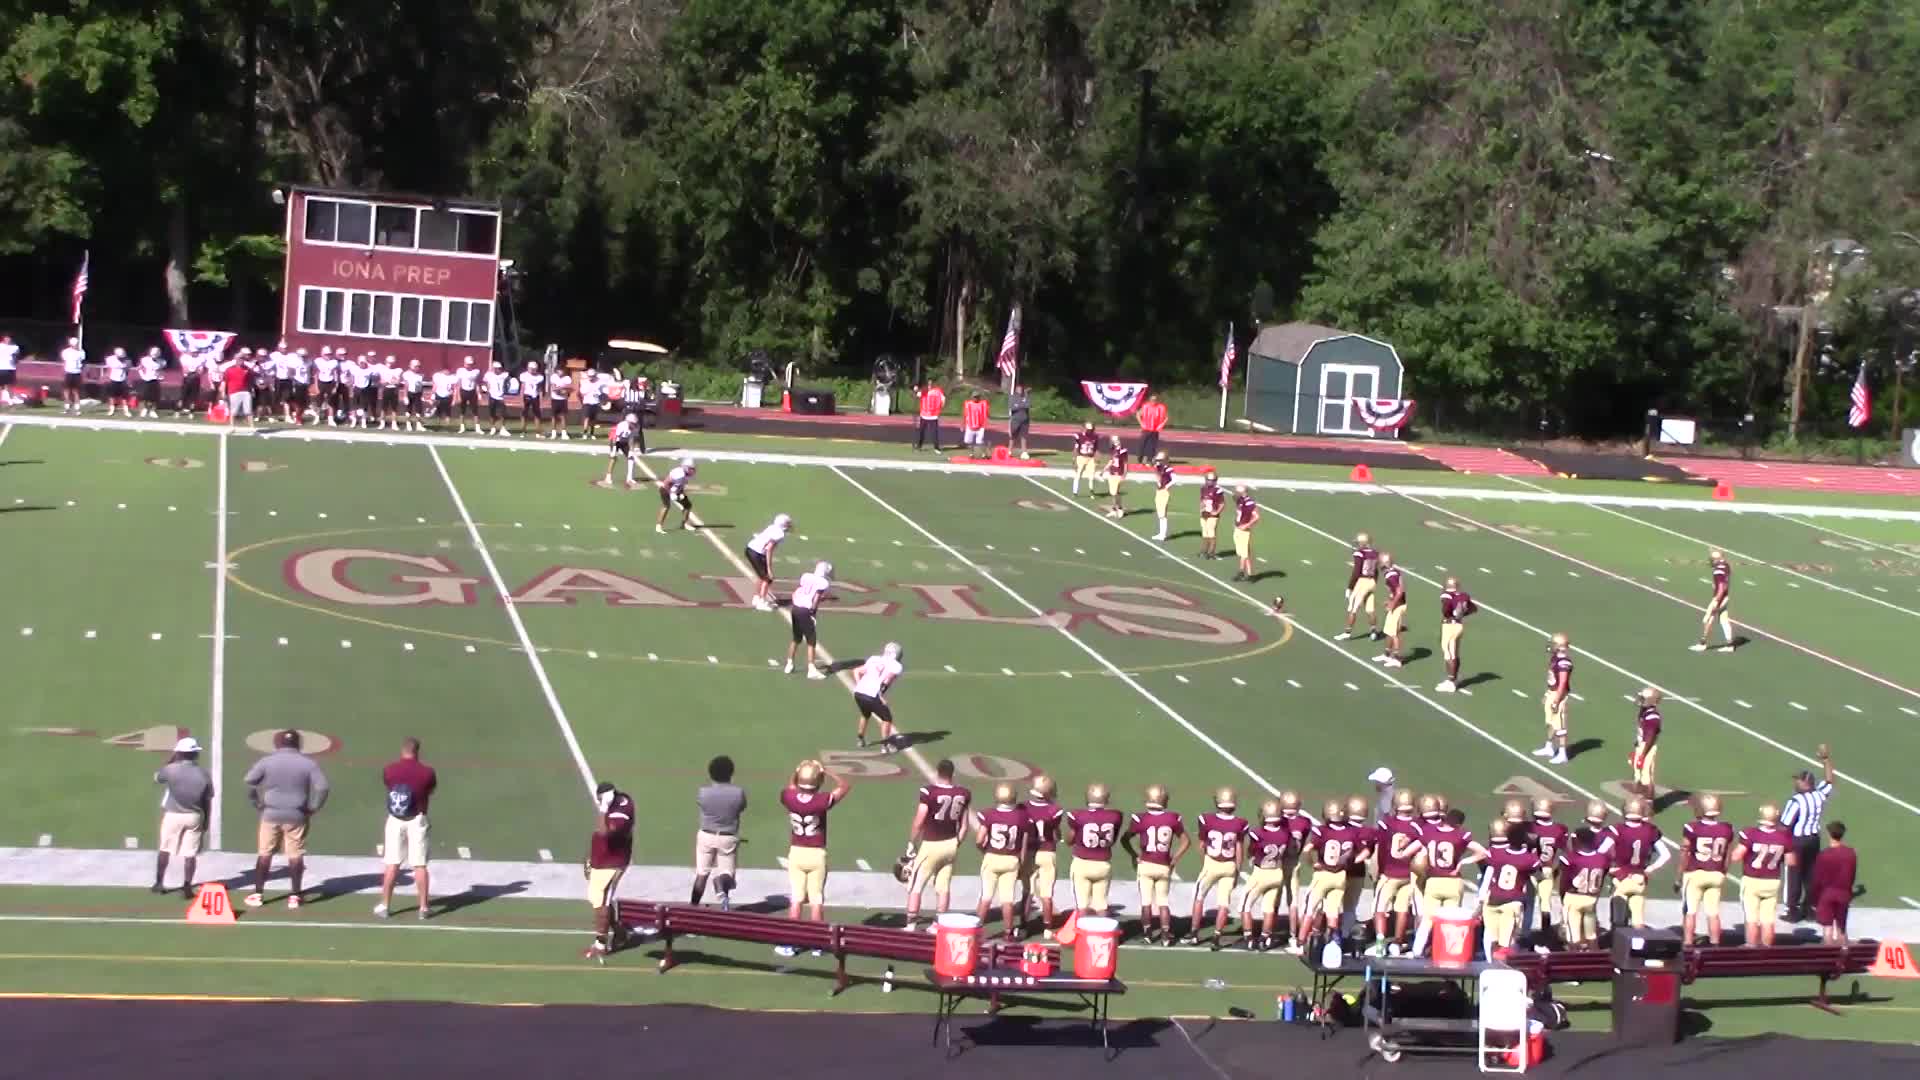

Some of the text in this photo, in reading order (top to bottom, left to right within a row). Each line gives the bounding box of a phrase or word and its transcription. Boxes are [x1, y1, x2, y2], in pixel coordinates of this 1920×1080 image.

[332, 259, 452, 285] IONA PREP
[284, 548, 1259, 645] GAELS
[818, 750, 1043, 781] 50
[990, 823, 1018, 850] 51
[1082, 822, 1115, 849] 63
[1145, 825, 1173, 852] 19
[1206, 829, 1237, 858] 33
[1427, 840, 1454, 868] 13
[1630, 839, 1642, 865] 1
[1695, 837, 1727, 862] 50
[1752, 843, 1784, 869] 77
[1498, 864, 1518, 890] 8
[202, 891, 224, 916] 40
[1885, 946, 1905, 970] 40
